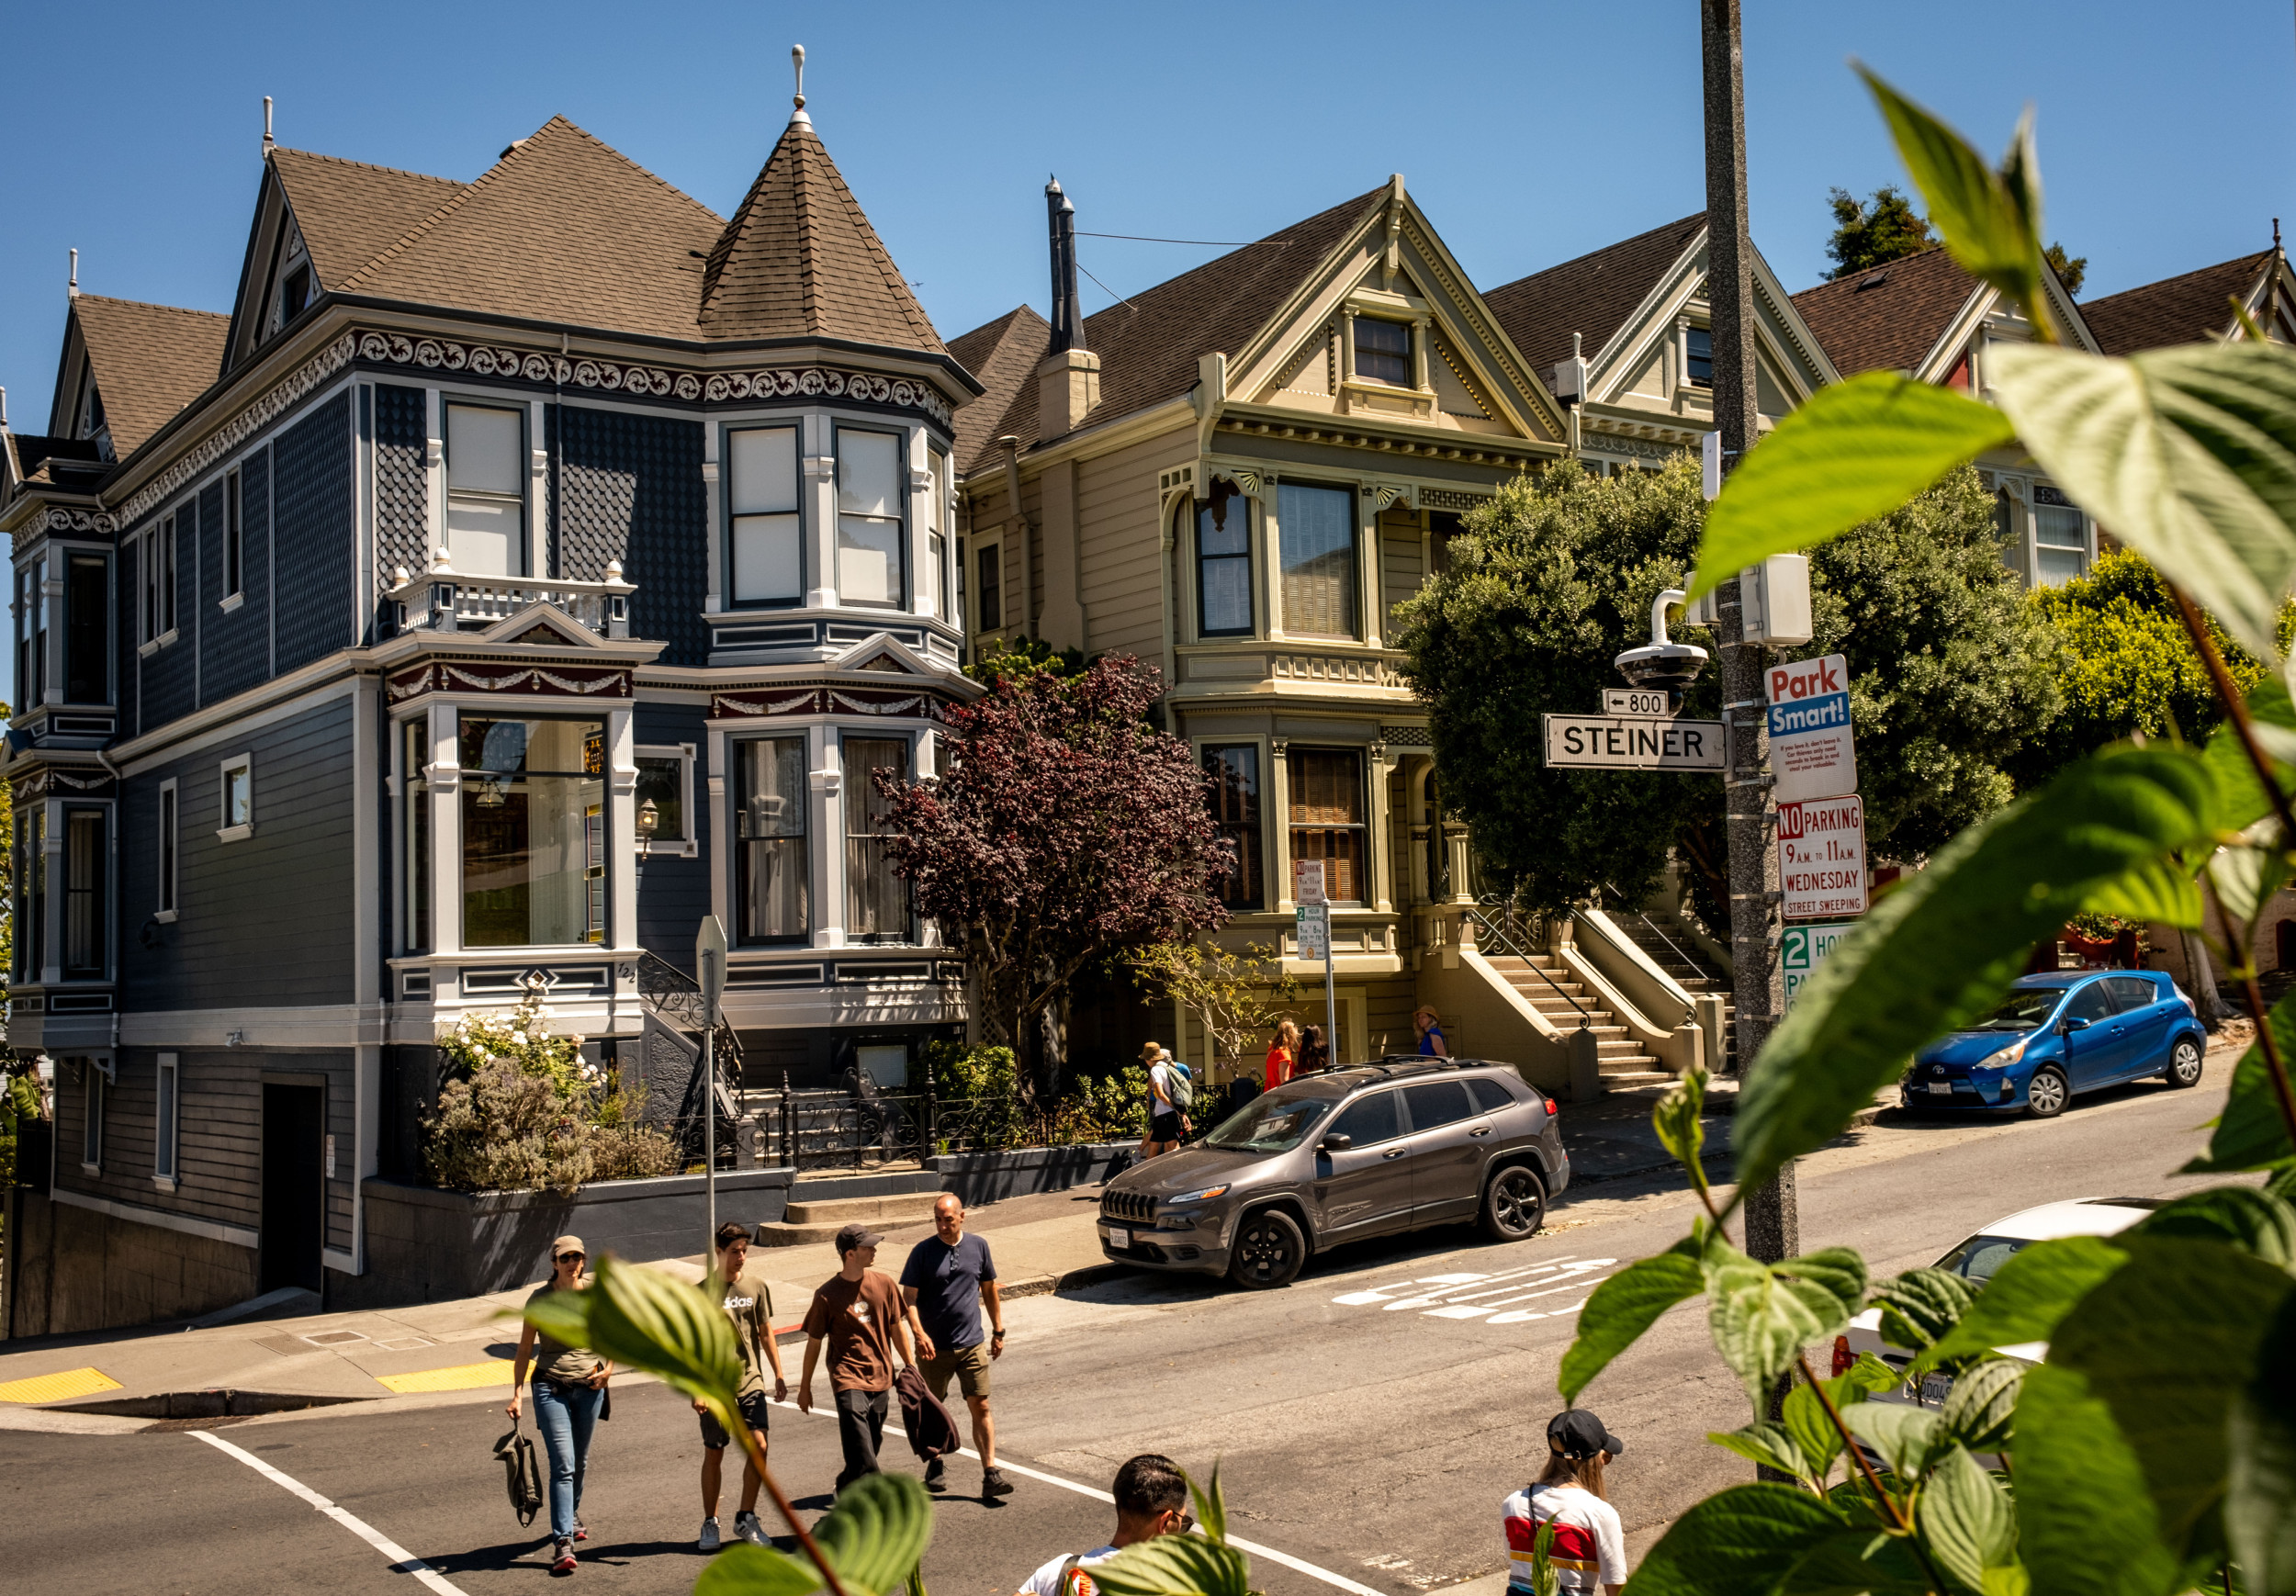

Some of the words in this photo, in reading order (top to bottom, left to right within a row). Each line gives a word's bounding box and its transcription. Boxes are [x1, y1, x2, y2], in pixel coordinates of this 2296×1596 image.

[1772, 659, 1840, 702] Park
[1630, 694, 1661, 713] 800
[1773, 697, 1844, 732] Smart!
[1564, 726, 1704, 757] STEINER
[1779, 807, 1801, 836] NO
[1805, 807, 1858, 833] PARKING
[1786, 870, 1858, 892] WEDNESDAY
[1298, 909, 1303, 920] 2
[1788, 901, 1816, 913] STREET
[1819, 898, 1860, 911] SWEEPING
[1785, 931, 1806, 966] 2
[1816, 935, 1847, 957] HO
[618, 962, 636, 984] 722
[722, 1296, 753, 1309] idas
